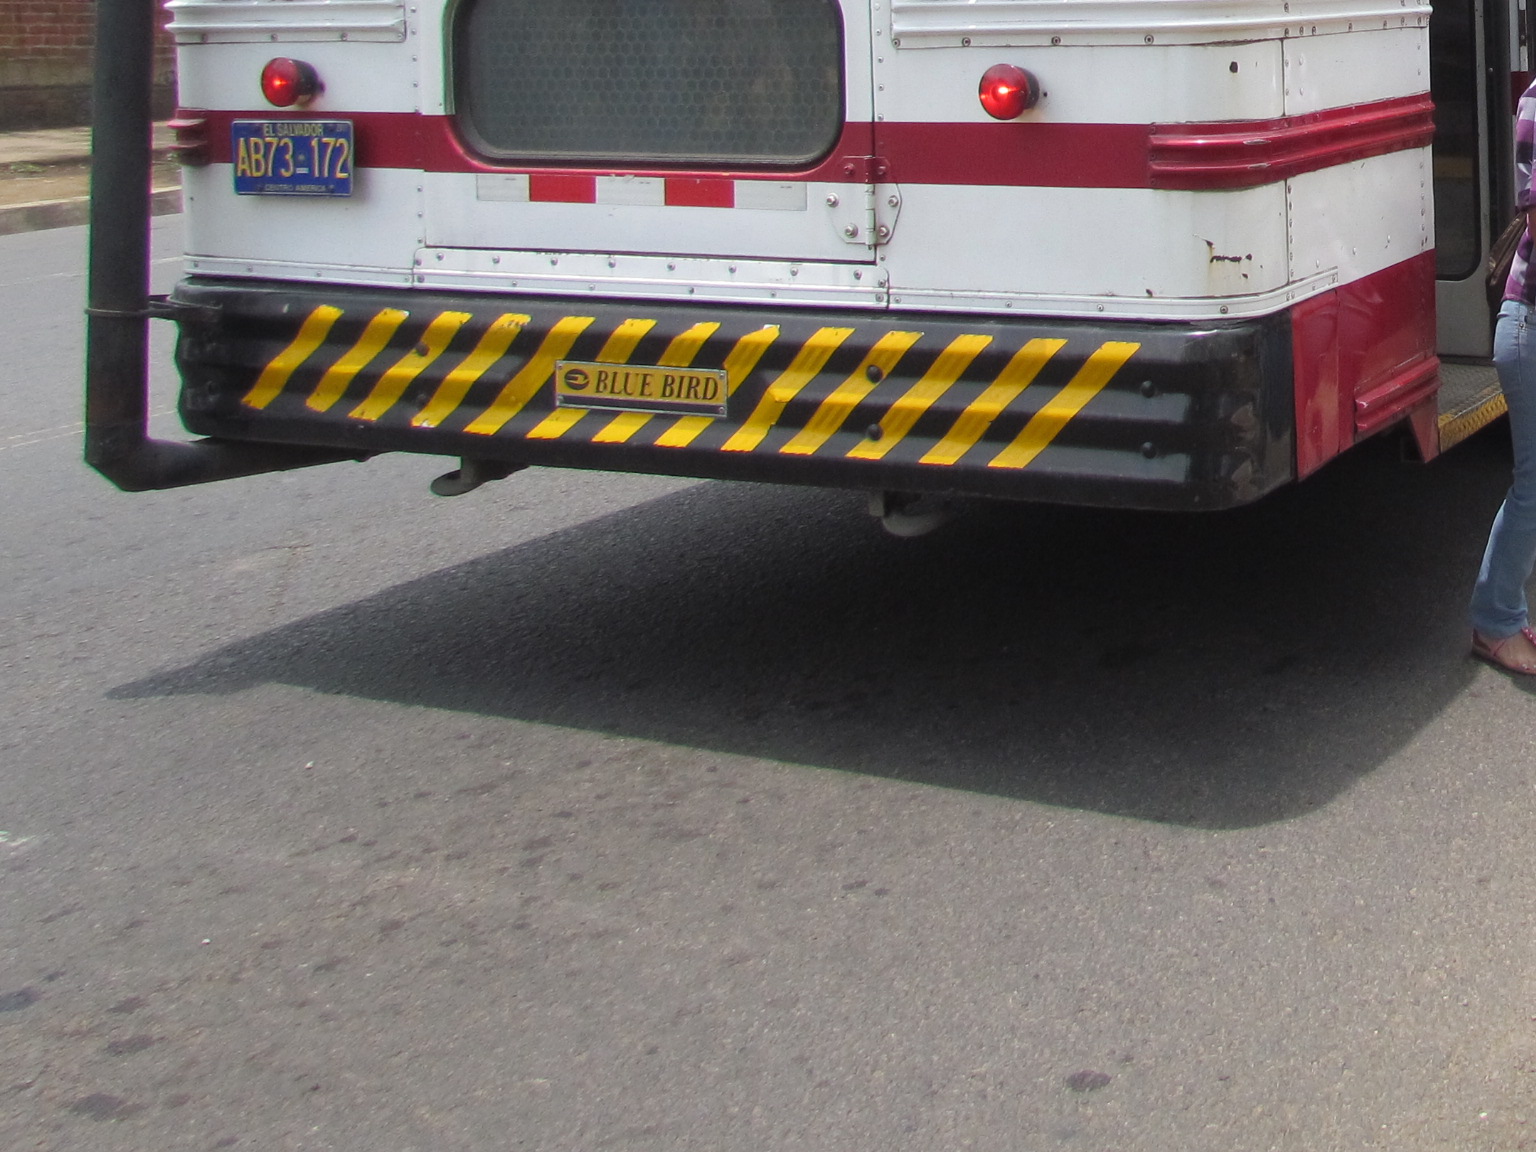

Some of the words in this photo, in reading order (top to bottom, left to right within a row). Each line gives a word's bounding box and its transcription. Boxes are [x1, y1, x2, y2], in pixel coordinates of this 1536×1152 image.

[263, 124, 275, 137] EL
[277, 124, 324, 137] SALVADOR
[595, 370, 654, 397] BLUE
[660, 374, 720, 401] BIRD
